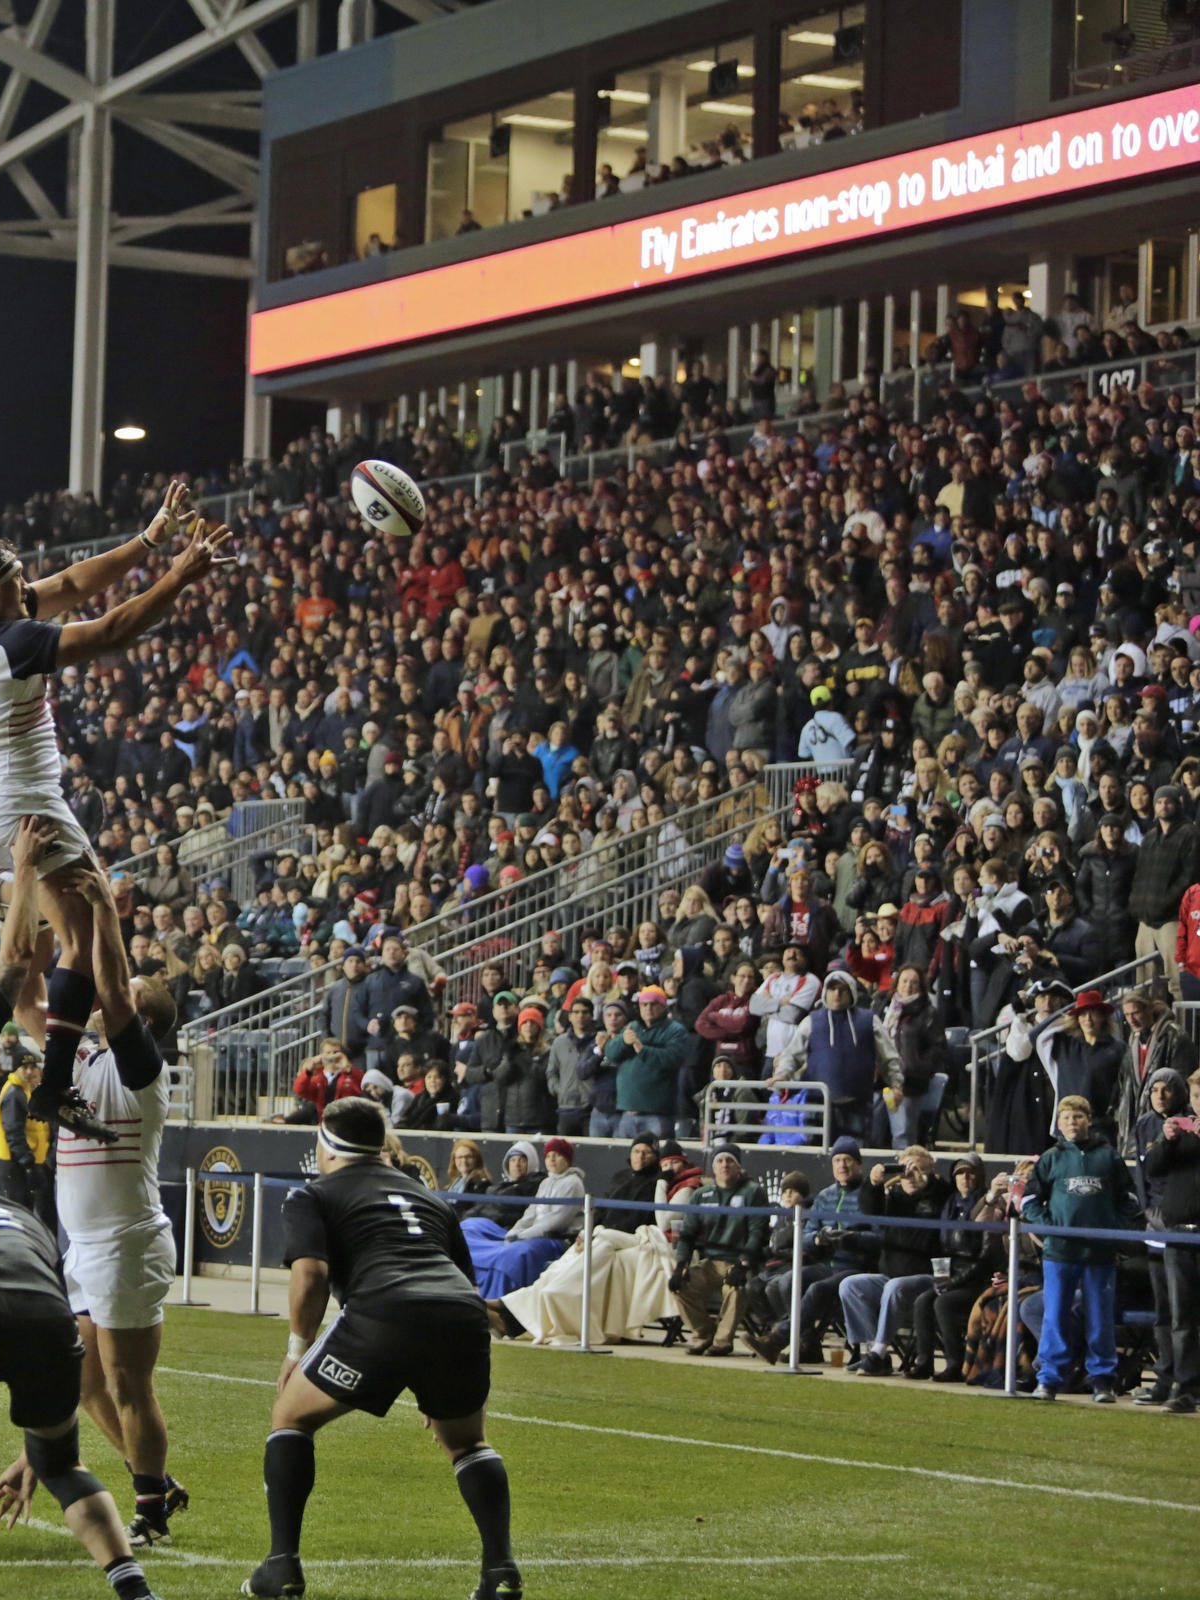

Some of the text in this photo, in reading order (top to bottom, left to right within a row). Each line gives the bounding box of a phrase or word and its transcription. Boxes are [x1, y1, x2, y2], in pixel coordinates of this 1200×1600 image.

[641, 226, 678, 274] Fly
[681, 210, 779, 260] Emirates
[784, 181, 892, 236] non-stop
[898, 172, 926, 208] to
[931, 143, 1005, 201] Dubai
[1011, 130, 1061, 183] and
[1067, 131, 1103, 170] on
[1111, 122, 1141, 160] to
[374, 463, 424, 513] GILBERT
[388, 1195, 423, 1235] 1
[323, 1361, 355, 1386] AIG
